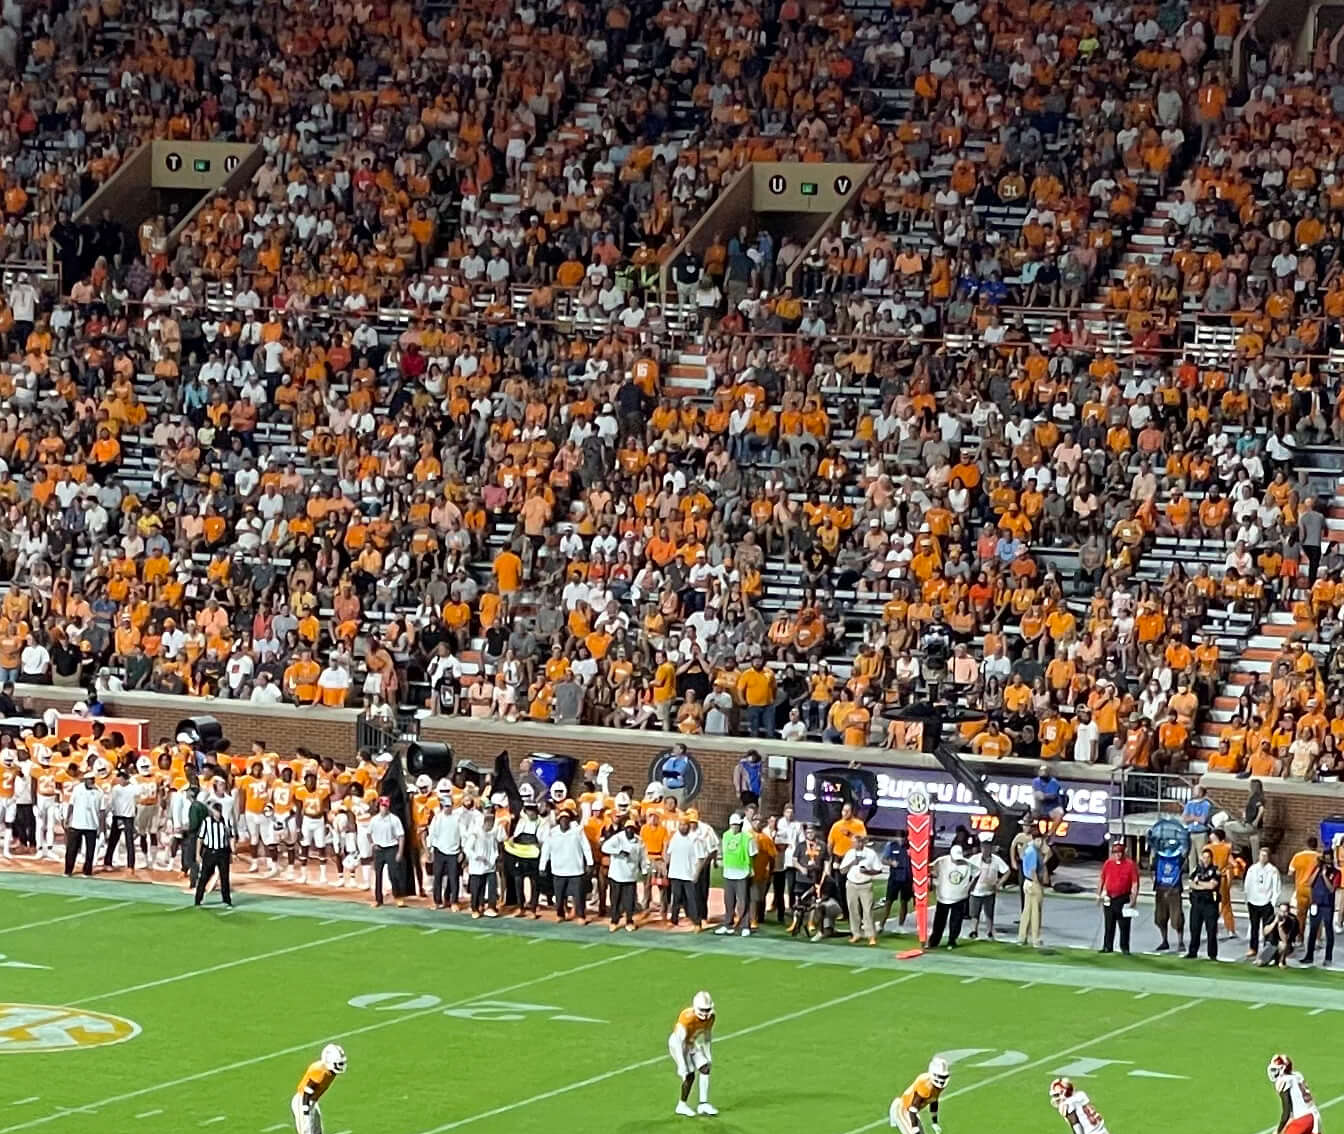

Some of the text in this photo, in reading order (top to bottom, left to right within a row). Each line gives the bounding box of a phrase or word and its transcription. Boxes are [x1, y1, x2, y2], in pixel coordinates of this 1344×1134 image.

[169, 155, 178, 169] T
[772, 178, 849, 193] U V
